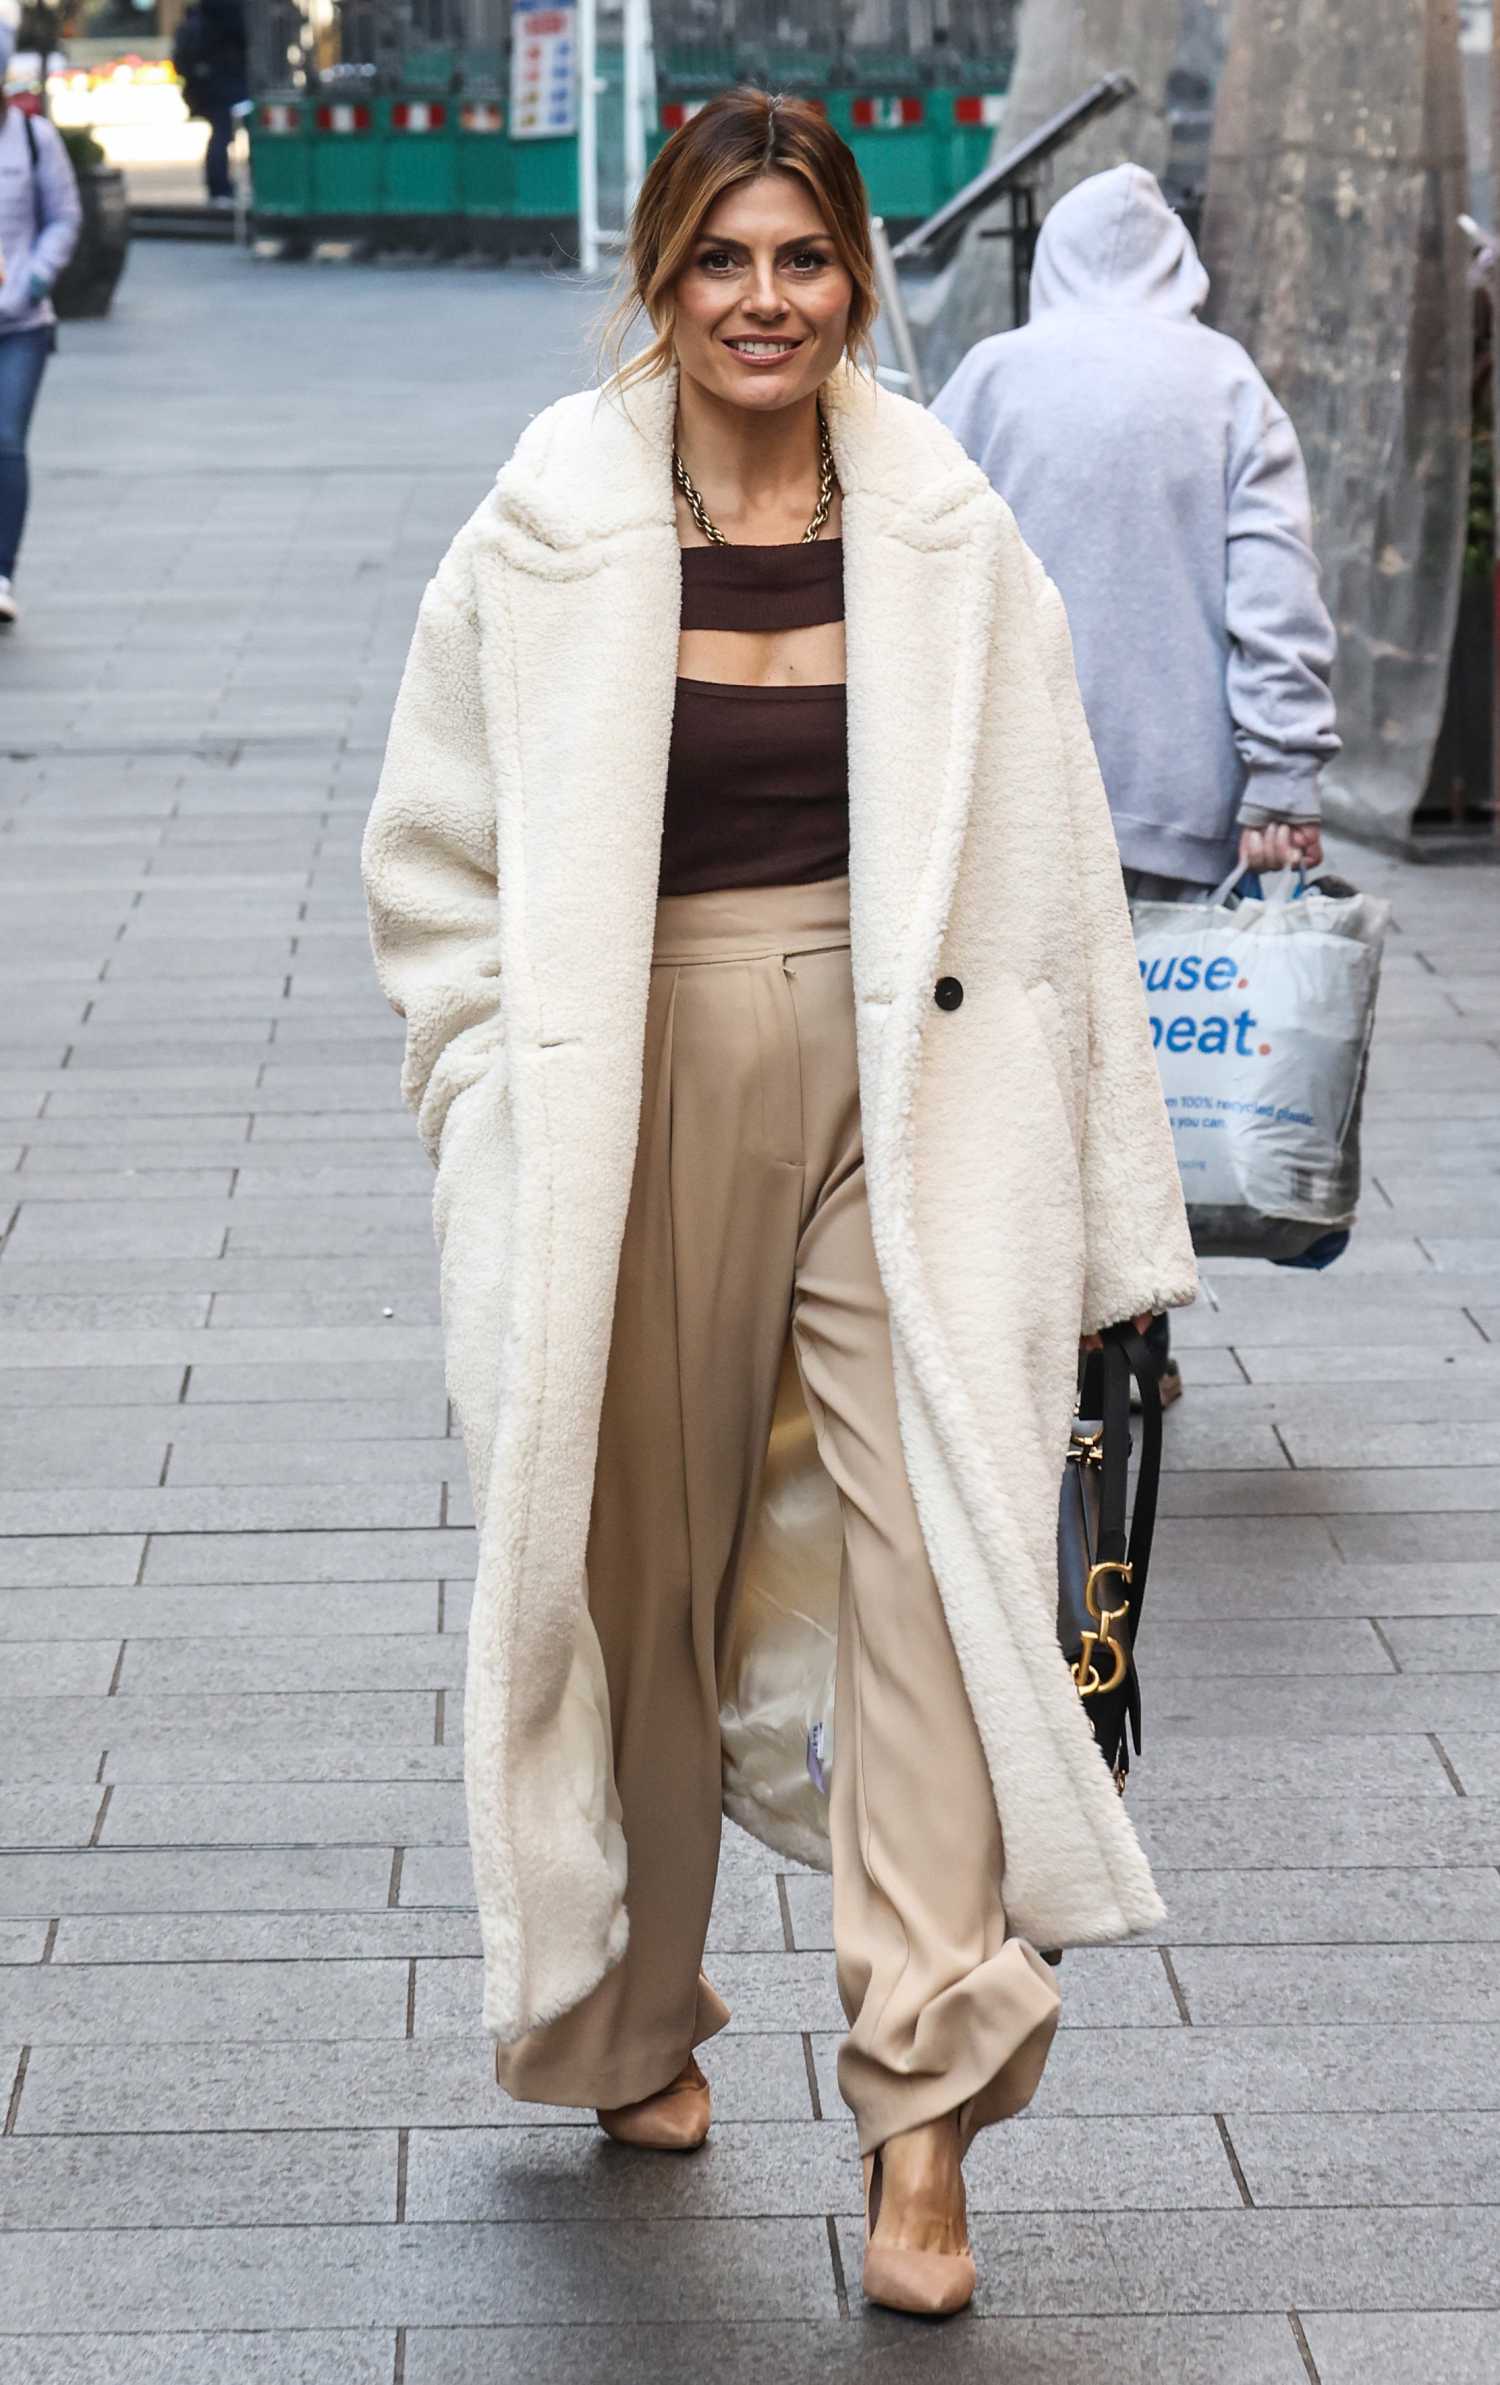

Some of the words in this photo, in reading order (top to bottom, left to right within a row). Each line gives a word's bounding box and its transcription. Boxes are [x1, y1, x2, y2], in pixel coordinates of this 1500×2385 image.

[1139, 955, 1248, 991] use.
[1182, 1096, 1213, 1109] 100%
[1178, 1118, 1199, 1130] you
